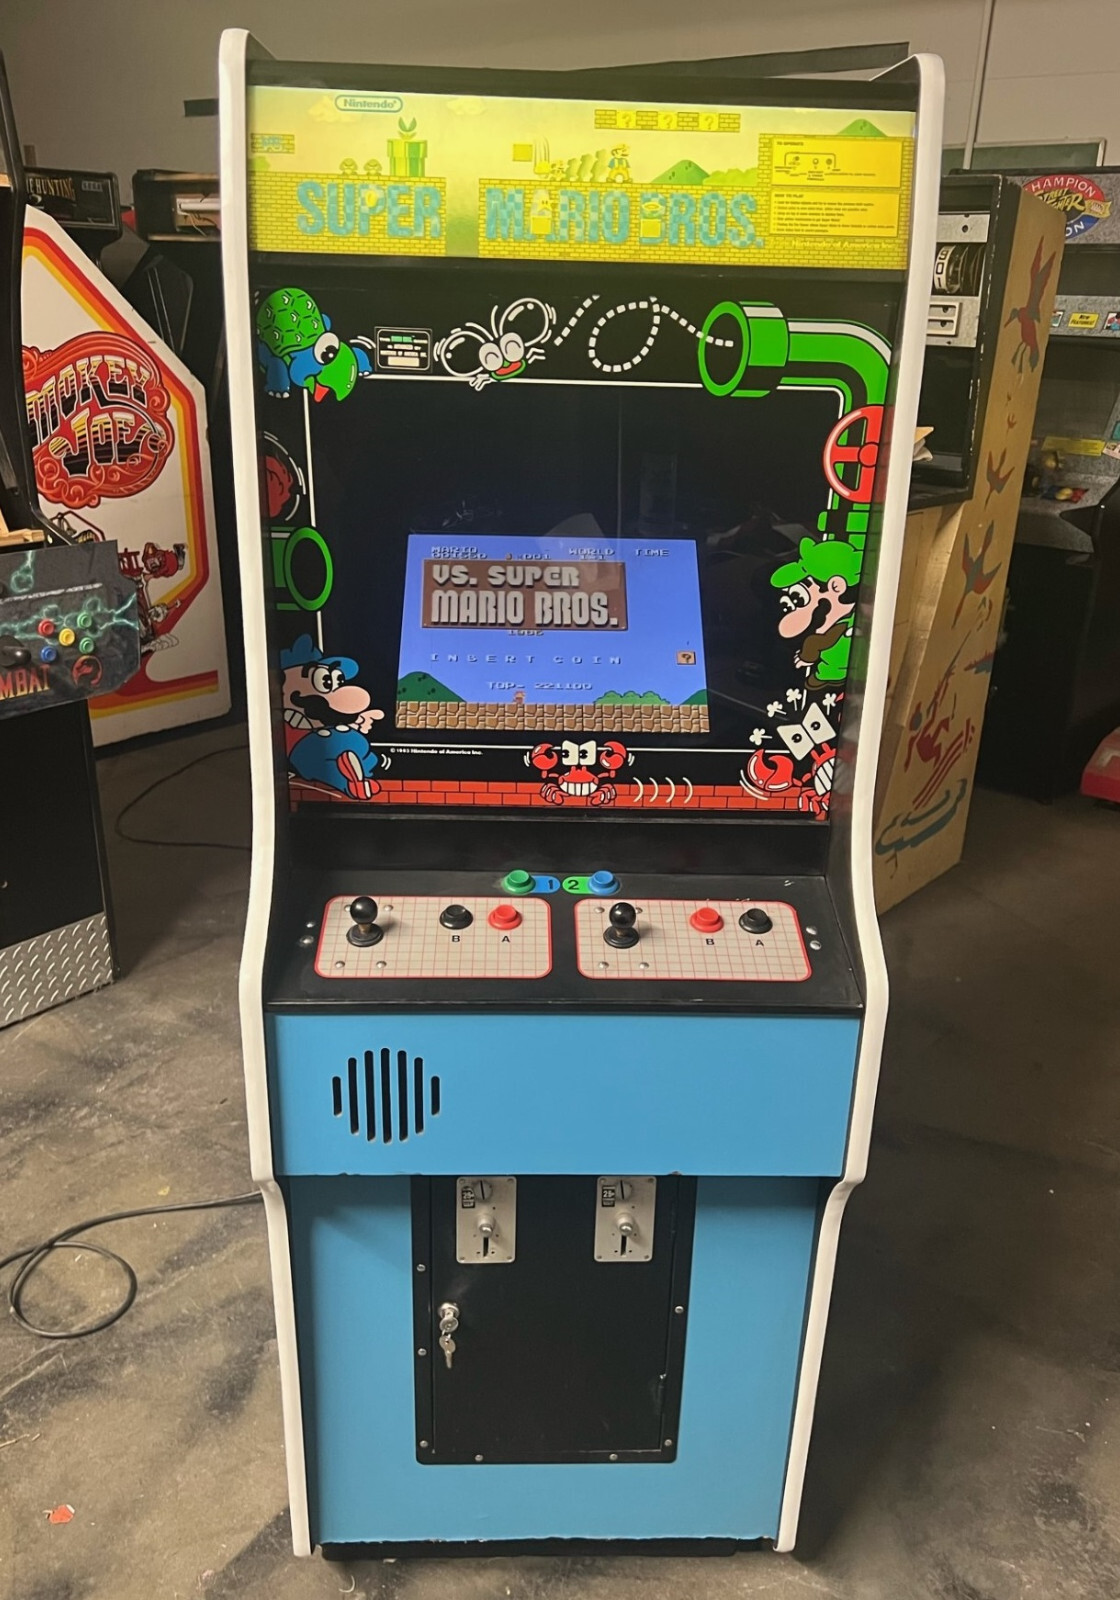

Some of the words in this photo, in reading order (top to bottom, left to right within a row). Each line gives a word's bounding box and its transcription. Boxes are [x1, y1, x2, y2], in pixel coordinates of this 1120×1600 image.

[344, 98, 394, 109] Nintendo
[1025, 177, 1096, 197] HAMPION
[297, 181, 442, 238] SUPER
[639, 191, 765, 249] BROS.
[26, 354, 151, 449] MOKEY
[49, 408, 160, 478] JOE
[431, 546, 479, 554] MARIO
[569, 547, 615, 556] WORLD
[635, 548, 670, 557] TIME
[432, 564, 478, 587] VS.
[487, 565, 580, 587] SUPER
[431, 590, 525, 626] MARIO
[535, 591, 620, 627] BROS.
[430, 653, 536, 664] INSERT
[552, 655, 622, 665] COIN
[547, 880, 554, 890] 1
[567, 879, 580, 891] 2
[451, 935, 461, 943] B
[501, 935, 511, 943] A
[705, 938, 715, 946] B
[755, 939, 765, 947] A
